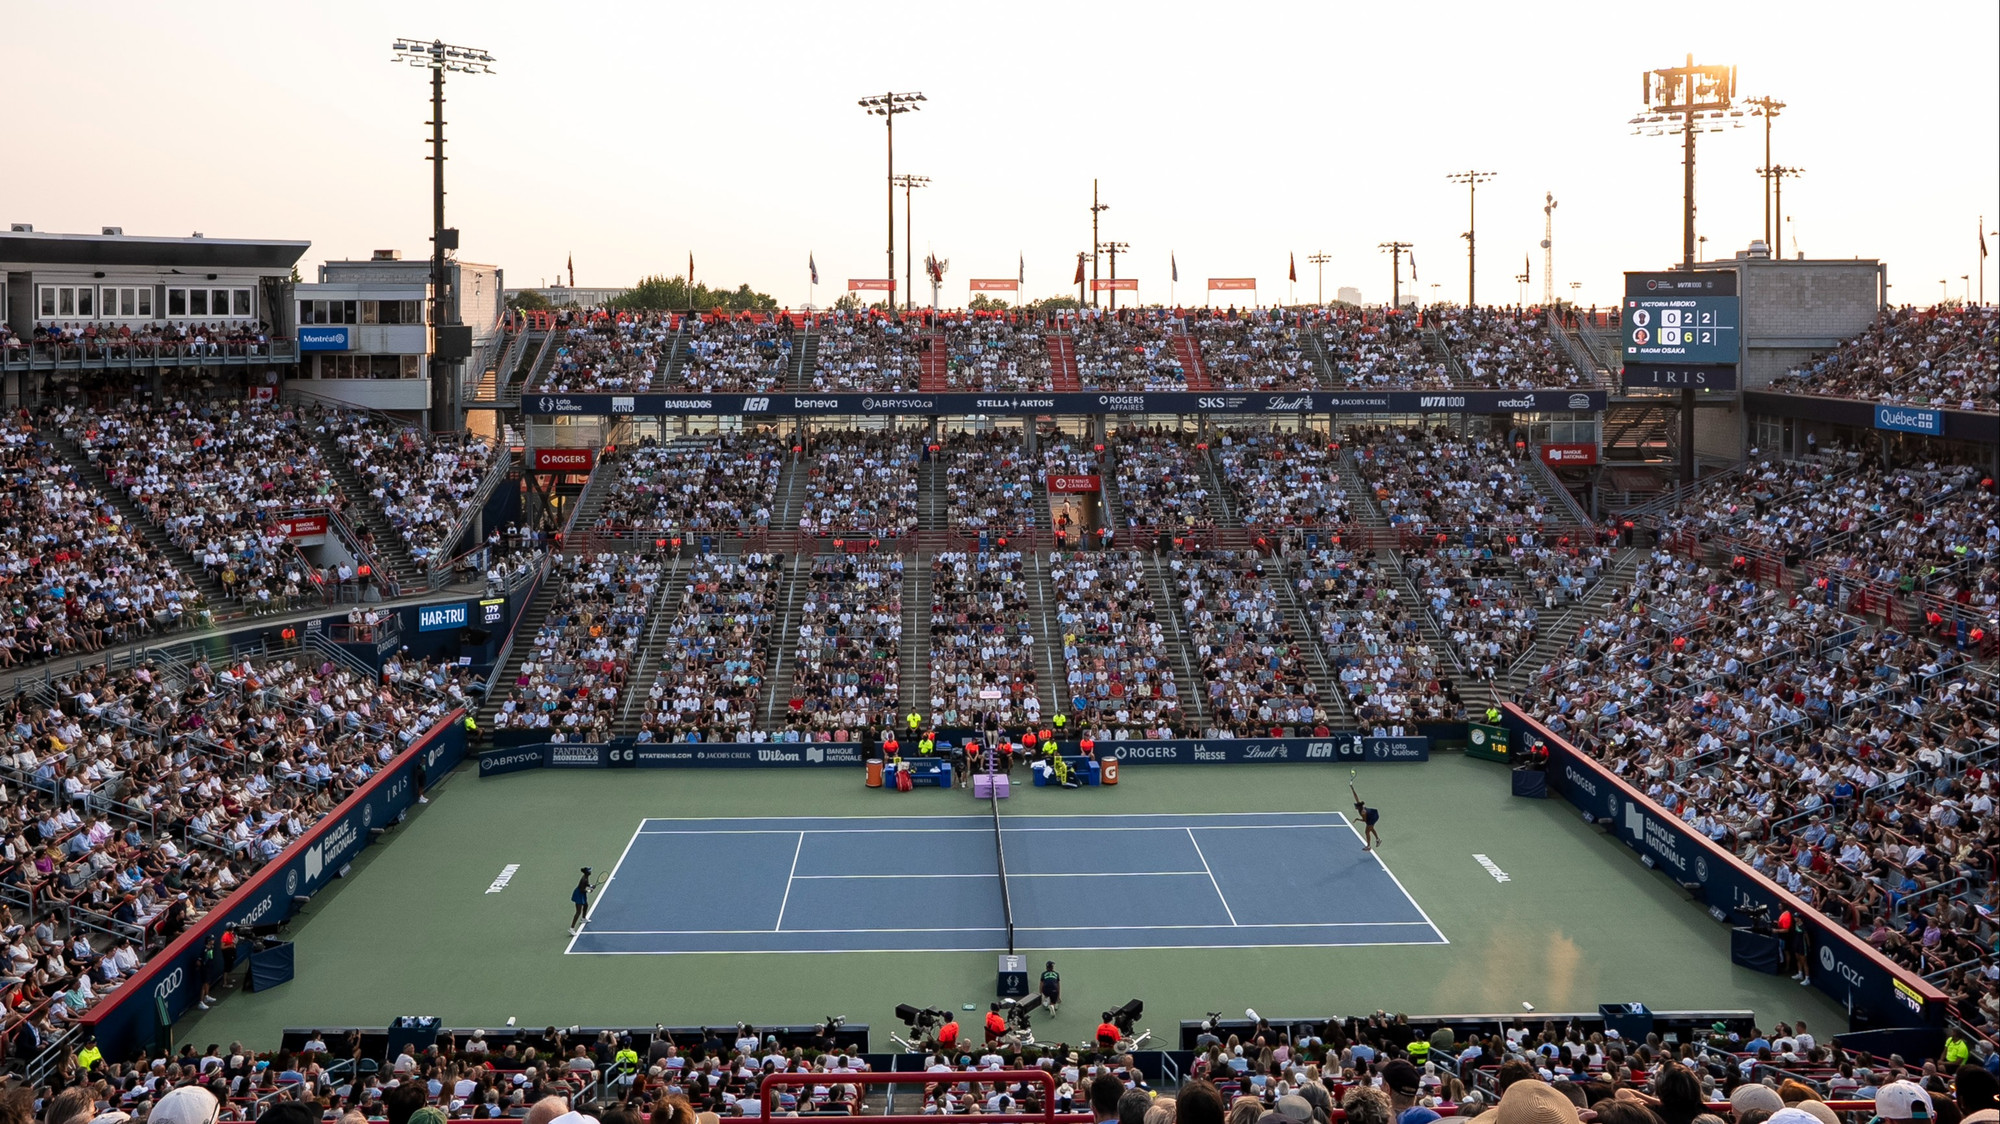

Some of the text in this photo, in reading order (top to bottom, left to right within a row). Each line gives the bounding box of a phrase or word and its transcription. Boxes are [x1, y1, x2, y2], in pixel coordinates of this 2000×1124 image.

[1667, 313, 1710, 323] 0 2 2
[303, 334, 336, 343] Montréal
[1667, 331, 1710, 343] 0 6 2
[1653, 371, 1705, 383] IRIS
[612, 405, 635, 413] KIND
[665, 400, 712, 409] BARBADOS
[742, 398, 770, 411] IGA
[795, 398, 838, 408] beneva
[874, 399, 933, 409] ABRYSVO.ca
[1020, 399, 1054, 407] ARTOIS
[1198, 397, 1225, 409] SKS
[1265, 396, 1305, 410] Lindt
[1881, 409, 1918, 426] Québec
[552, 455, 585, 463] ROGERS
[485, 605, 499, 613] 179
[421, 608, 465, 626] HAR-TRU
[1490, 734, 1507, 742] ROLEX
[1129, 747, 1177, 758] ROGERS
[1194, 744, 1206, 752] LA
[1243, 744, 1278, 758] Lindt
[1306, 743, 1333, 757] IGA
[1340, 744, 1350, 755] G
[1391, 748, 1419, 756] Québec
[1492, 743, 1507, 753] 1:00
[609, 750, 633, 760] G G
[758, 749, 800, 761] Wilson
[1194, 752, 1225, 760] PRESSE
[387, 776, 408, 802] IRIS
[1572, 770, 1596, 797] ROGERS
[324, 819, 349, 851] BANQUE
[1645, 817, 1676, 849] BANQUE
[325, 827, 357, 866] NATIONALE
[1646, 832, 1686, 872] NATIONALE
[1837, 961, 1865, 987] razr
[1906, 997, 1920, 1013] 179
